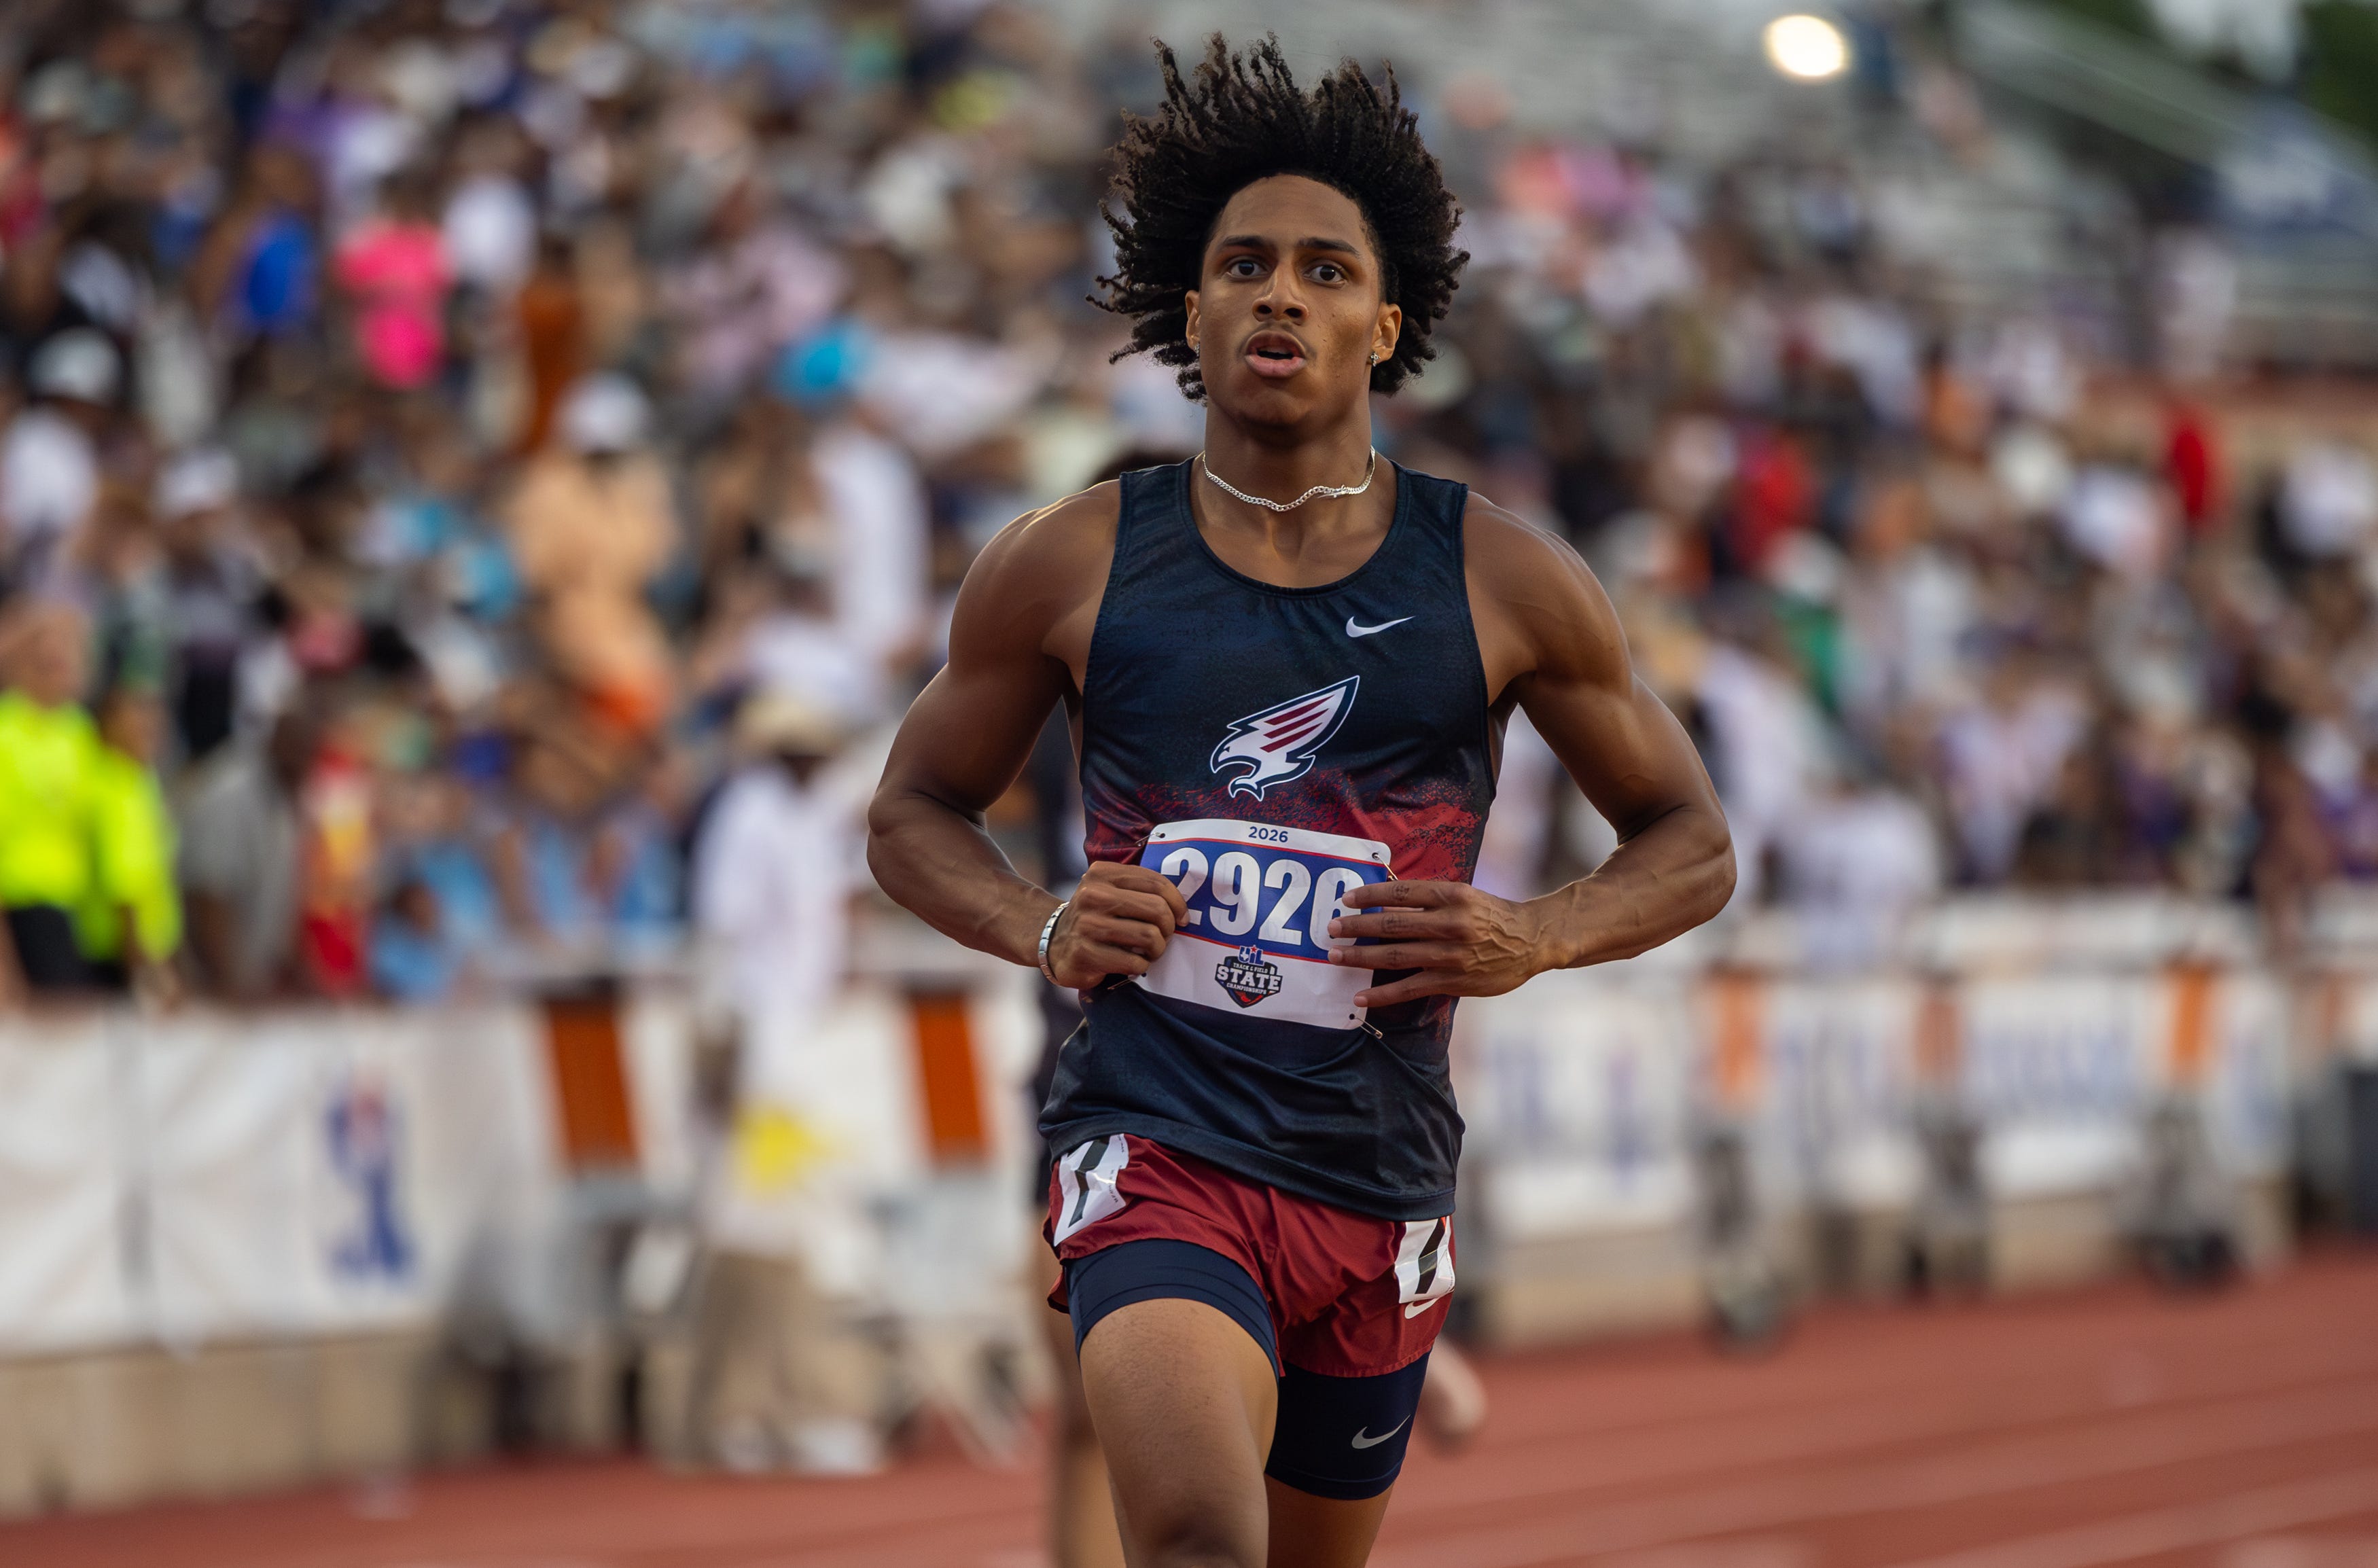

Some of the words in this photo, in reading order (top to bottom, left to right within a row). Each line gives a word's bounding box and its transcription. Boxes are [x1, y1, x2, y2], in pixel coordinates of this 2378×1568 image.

[1248, 826, 1289, 843] 2026
[1160, 847, 1365, 952] 2926
[1232, 963, 1249, 971] TRACK
[1216, 965, 1281, 991] STATE
[1226, 982, 1267, 995] CHAMPIONSHIPS
